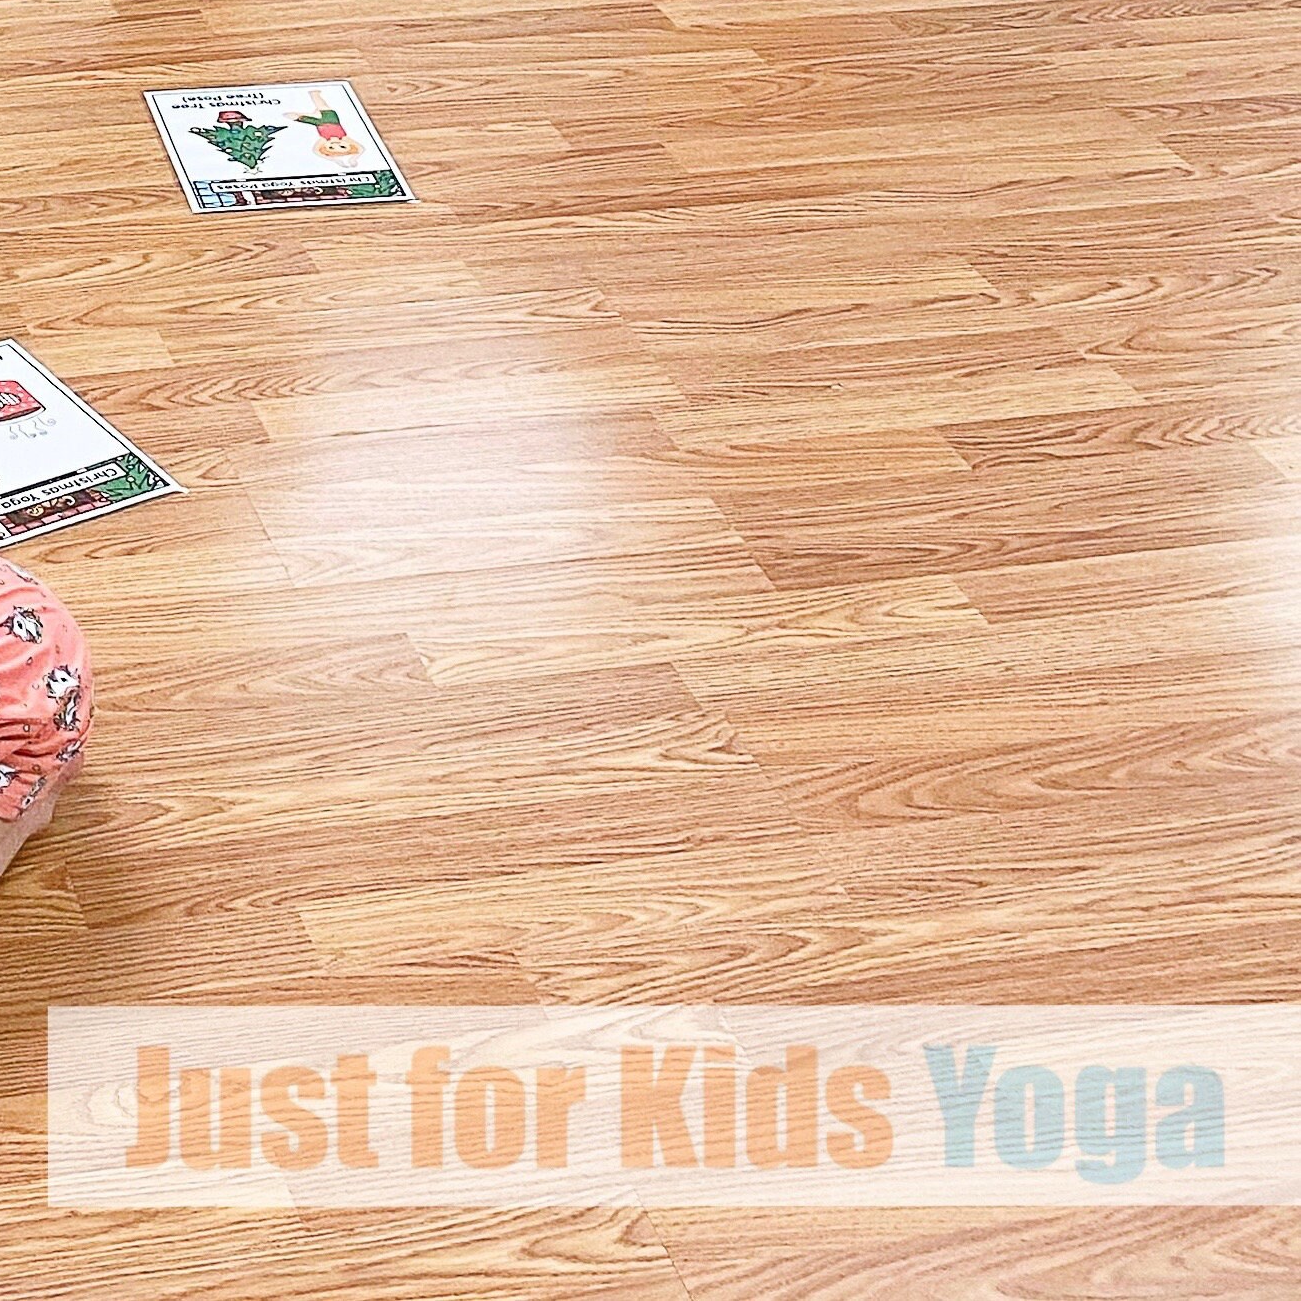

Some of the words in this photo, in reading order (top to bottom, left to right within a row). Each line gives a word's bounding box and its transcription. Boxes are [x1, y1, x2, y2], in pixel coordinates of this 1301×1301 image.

[182, 95, 222, 103] Pose)
[226, 92, 264, 100] (Tree
[209, 98, 281, 107] Christmas
[261, 180, 295, 189] Yoga
[299, 175, 370, 186] Christmas
[216, 183, 258, 191] Poses
[41, 468, 118, 497] Christmas
[2, 493, 41, 510] Yoga
